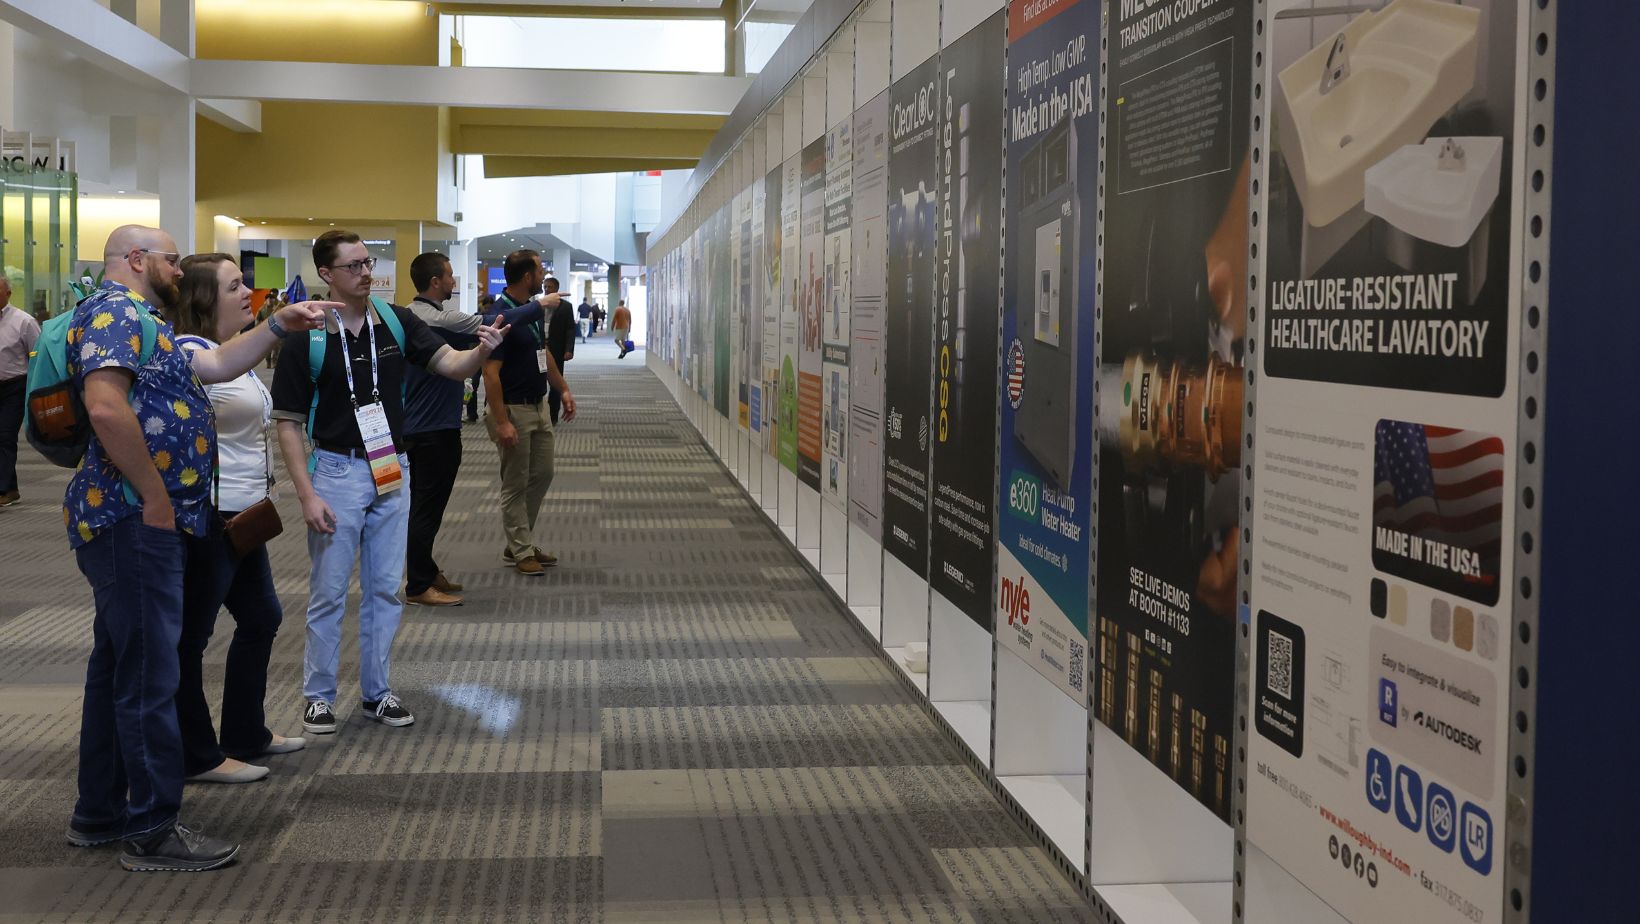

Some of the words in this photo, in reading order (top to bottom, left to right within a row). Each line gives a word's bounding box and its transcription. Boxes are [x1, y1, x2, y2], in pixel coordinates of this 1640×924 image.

[1120, 4, 1172, 49] TRANSITION
[1018, 62, 1031, 98] High
[1032, 59, 1051, 88] Temp.
[1052, 49, 1066, 77] Low
[1067, 34, 1086, 69] GWP.
[1012, 98, 1038, 143] Made
[1039, 93, 1049, 132] in
[1050, 86, 1068, 127] the
[1069, 73, 1093, 119] USA
[942, 67, 956, 342] LegendPress
[1272, 272, 1458, 311] LIGATURE-RESISTANT
[1271, 318, 1373, 353] HEALTHCARE
[1378, 319, 1489, 358] LAVATORY
[939, 345, 950, 442] CSG
[1140, 376, 1149, 424] viega
[1010, 478, 1037, 516] e360
[1042, 481, 1056, 506] Heat
[1057, 488, 1075, 518] Pump
[1041, 507, 1059, 532] Water
[1059, 514, 1081, 542] Heater
[946, 561, 963, 584] LEGEND
[1376, 526, 1409, 557] MADE
[1410, 535, 1422, 561] IN
[1425, 539, 1448, 569] THE
[1450, 546, 1480, 578] USA
[1000, 576, 1030, 626] nyle
[1130, 566, 1144, 589] SEE
[1145, 573, 1161, 597] LIVE
[1162, 581, 1190, 612] DEMOS
[1129, 588, 1139, 607] AT
[1140, 593, 1167, 623] BOOTH
[1167, 608, 1190, 637] #1133
[1382, 653, 1398, 673] Easy
[1398, 660, 1406, 674] to
[1406, 666, 1439, 690] integrate
[1439, 678, 1446, 692] &
[1447, 683, 1481, 707] visualize
[1384, 685, 1393, 707] R
[1425, 715, 1483, 755] AUTODESK
[1468, 821, 1485, 850] LR
[1420, 870, 1433, 893] fax
